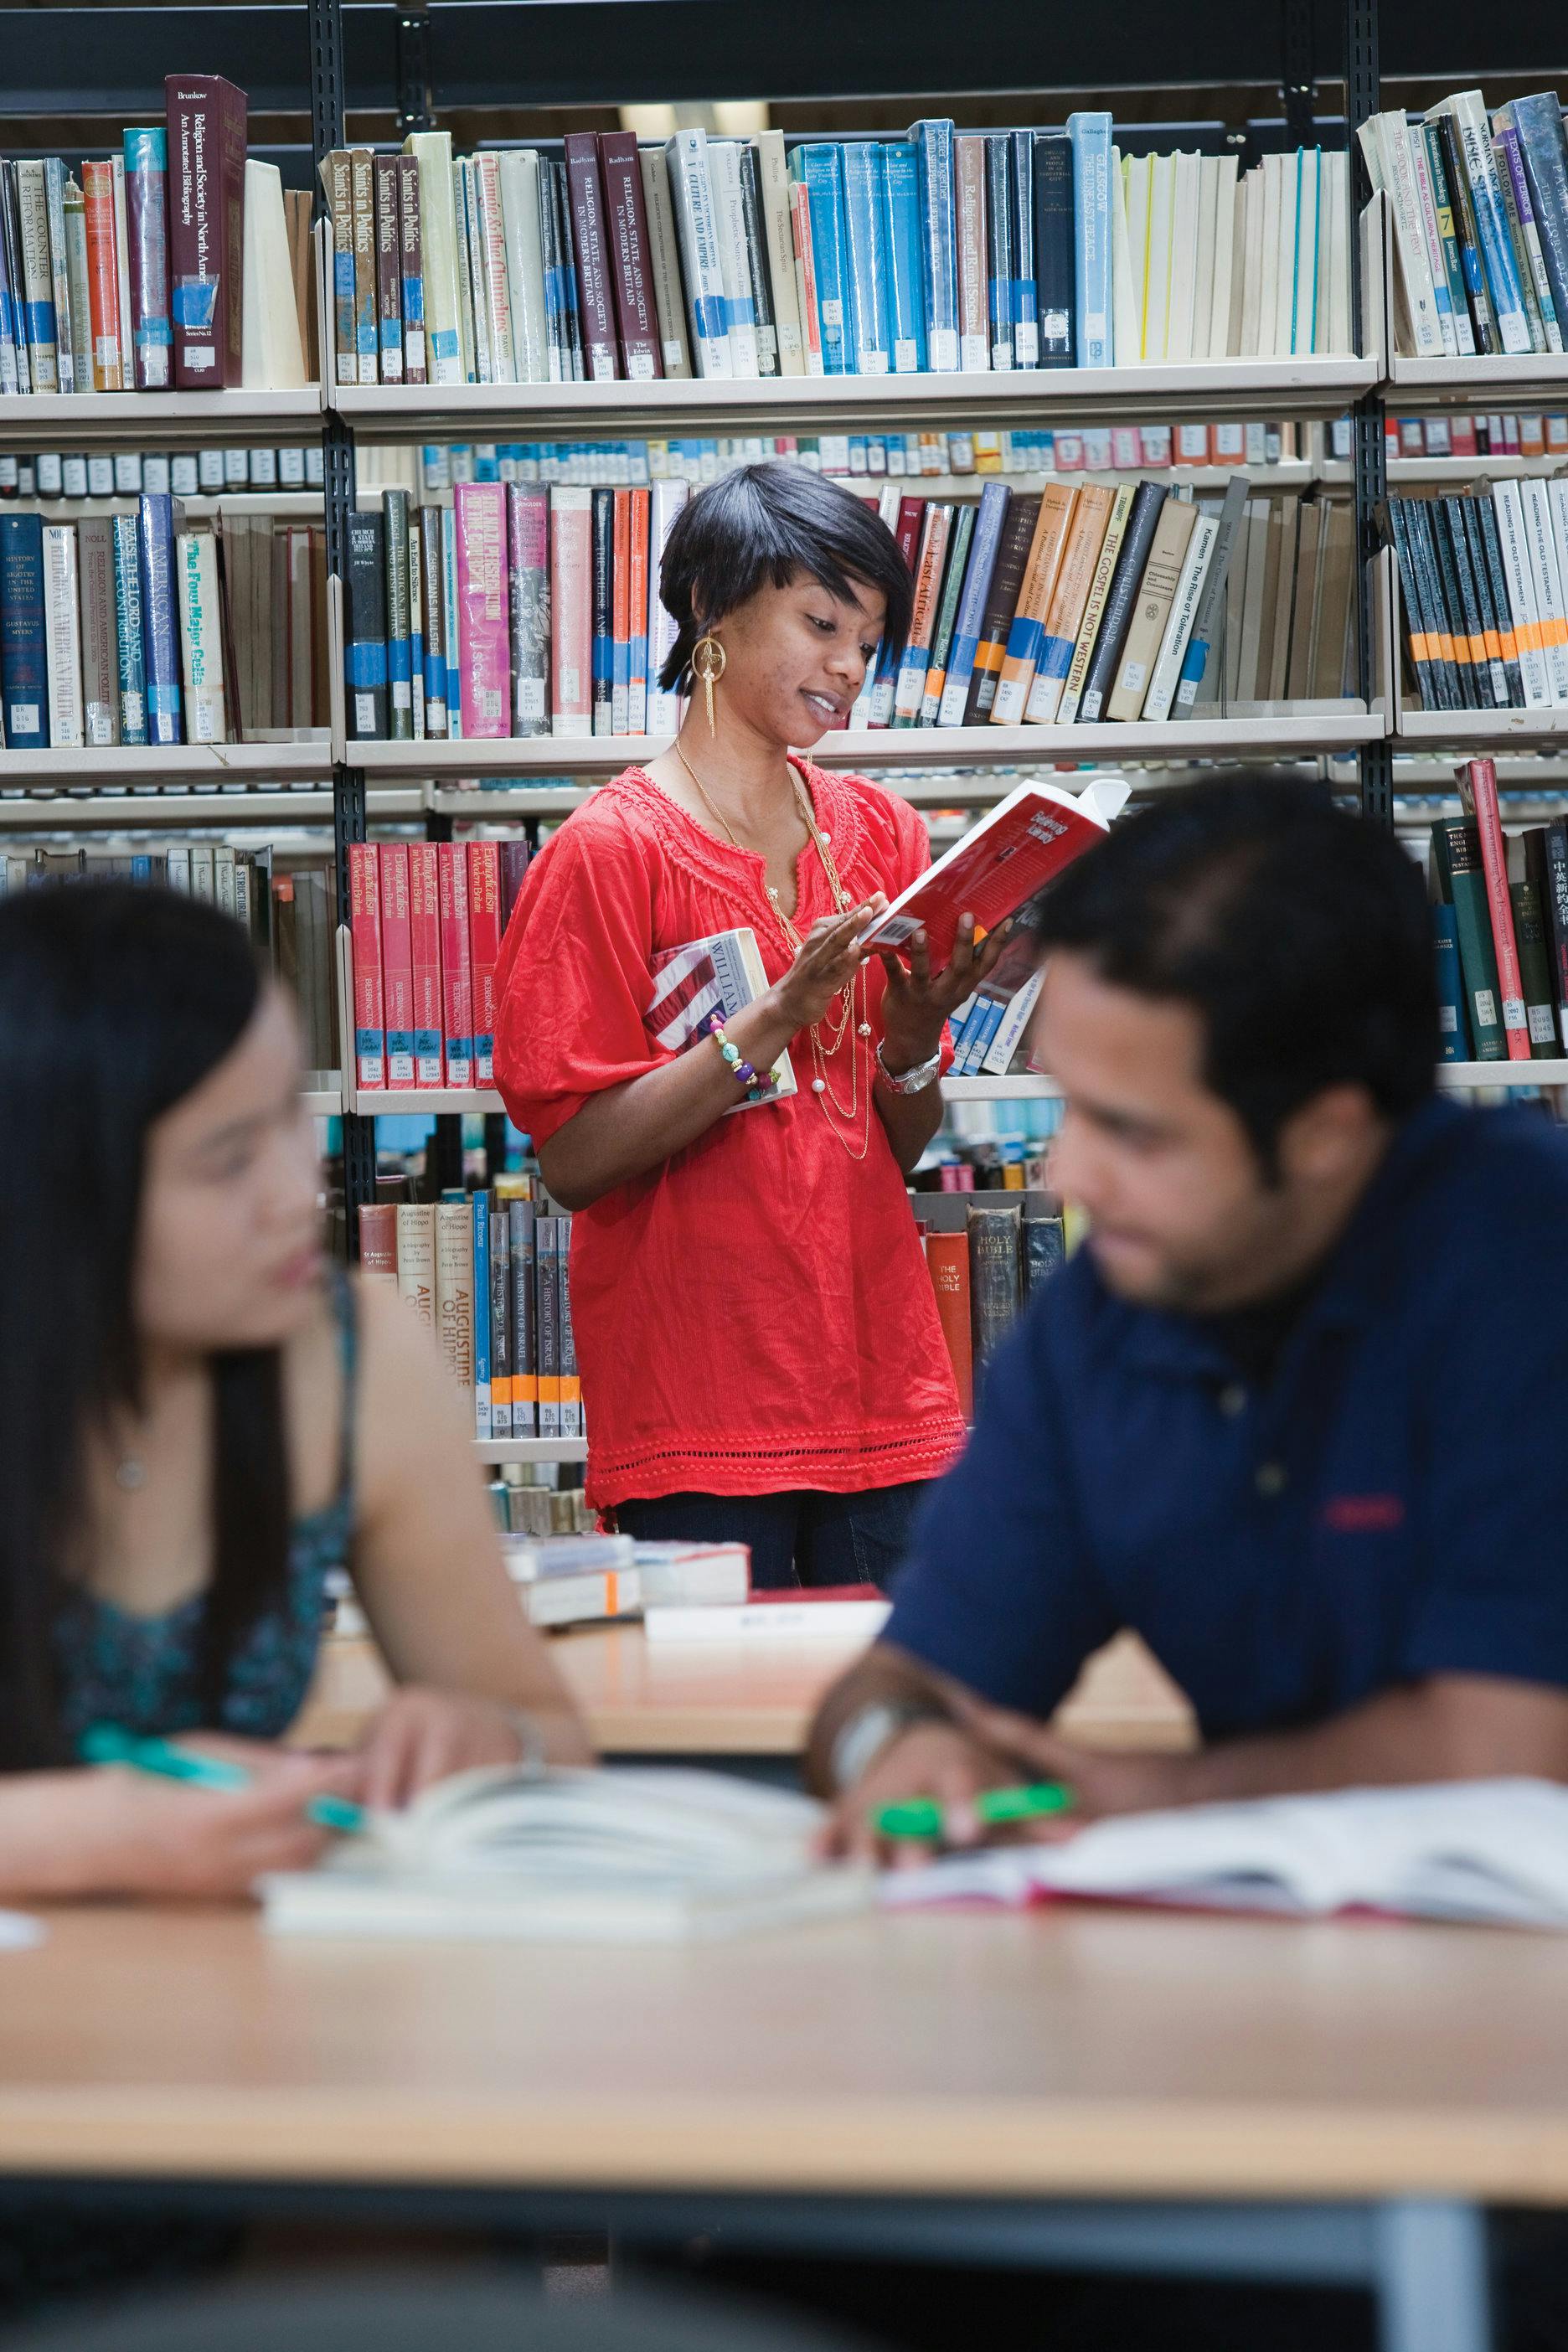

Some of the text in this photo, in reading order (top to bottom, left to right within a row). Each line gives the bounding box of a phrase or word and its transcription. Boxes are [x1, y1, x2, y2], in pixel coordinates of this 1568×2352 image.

[1480, 123, 1493, 164] NORMAN
[181, 114, 193, 226] An Annotated Bibliography
[1419, 170, 1427, 191] BIBLE
[1498, 154, 1516, 218] FOLLOW ME
[1509, 134, 1532, 216] TEXTS OF TERROR
[193, 113, 209, 285] Religion and Society in North Amer
[334, 164, 352, 253] Saints in Politics
[355, 163, 373, 253] Saints in Politics
[379, 169, 396, 253] Saints in Politics
[402, 169, 419, 253] Saints in Politics
[1423, 192, 1428, 201] AS
[1425, 202, 1434, 237] CULTURAL
[22, 186, 37, 280] REFORMATION
[34, 186, 49, 279] THE COUNTER
[963, 185, 978, 287] Religion Rural
[1441, 214, 1450, 230] 7
[578, 205, 594, 306] IN BRITAIN
[617, 205, 635, 305] IN MODERN BRITAIN
[1431, 239, 1441, 273] HERITAGE
[1446, 241, 1456, 258] James
[593, 267, 607, 333] AND SOCIETY
[633, 267, 648, 332] AND SOCIETY
[411, 539, 418, 547] An
[1504, 494, 1513, 528] READING
[1514, 563, 1526, 606] TESTAMENT
[1532, 493, 1541, 527] READING
[1542, 562, 1553, 606] TESTAMENT
[97, 551, 107, 595] RELIGION
[187, 540, 202, 646] The Four Major
[399, 565, 407, 605] VATICAN,
[411, 566, 418, 576] to
[428, 551, 438, 605] CHRISTIANS
[912, 548, 938, 635] East African
[1146, 582, 1173, 592] Conscience
[1149, 571, 1176, 582] Citizenship
[1172, 528, 1213, 656] Kamen The Rise of Toleration
[127, 563, 141, 662] THE LORD AND
[597, 614, 606, 638] AND
[1069, 534, 1119, 692] THE GOSPEL IS NOT WESTERN
[100, 619, 109, 668] AMERICAN
[938, 638, 948, 659] Robert
[237, 872, 247, 918] STRUCTURAL
[353, 859, 362, 889] Modern
[364, 848, 377, 915] Evangelicalism
[384, 863, 393, 891] Modern
[394, 854, 409, 919] Evangelicalism
[413, 858, 421, 888] Modern
[423, 849, 437, 914] Evangelicalism
[442, 863, 453, 893] Modern
[453, 854, 466, 919] Evangelicalism
[473, 857, 483, 887] Modern
[483, 848, 497, 913] Evangelicalism
[353, 890, 363, 915] Britain
[385, 893, 394, 919] Britain
[414, 889, 422, 914] Britain
[443, 893, 452, 919] Britain
[474, 888, 483, 913] Britain
[365, 979, 373, 1029] BEBBINGTON
[424, 978, 433, 1029] BEBBINGTON
[453, 983, 462, 1033] BEBBINGTON
[485, 976, 493, 1028] BEBBINGTON
[977, 1246, 1014, 1254] BIBLE
[980, 1236, 1012, 1245] HOLY
[455, 1289, 471, 1387] AUGUSTINE
[518, 1318, 525, 1331] OF
[544, 1326, 552, 1338] OF
